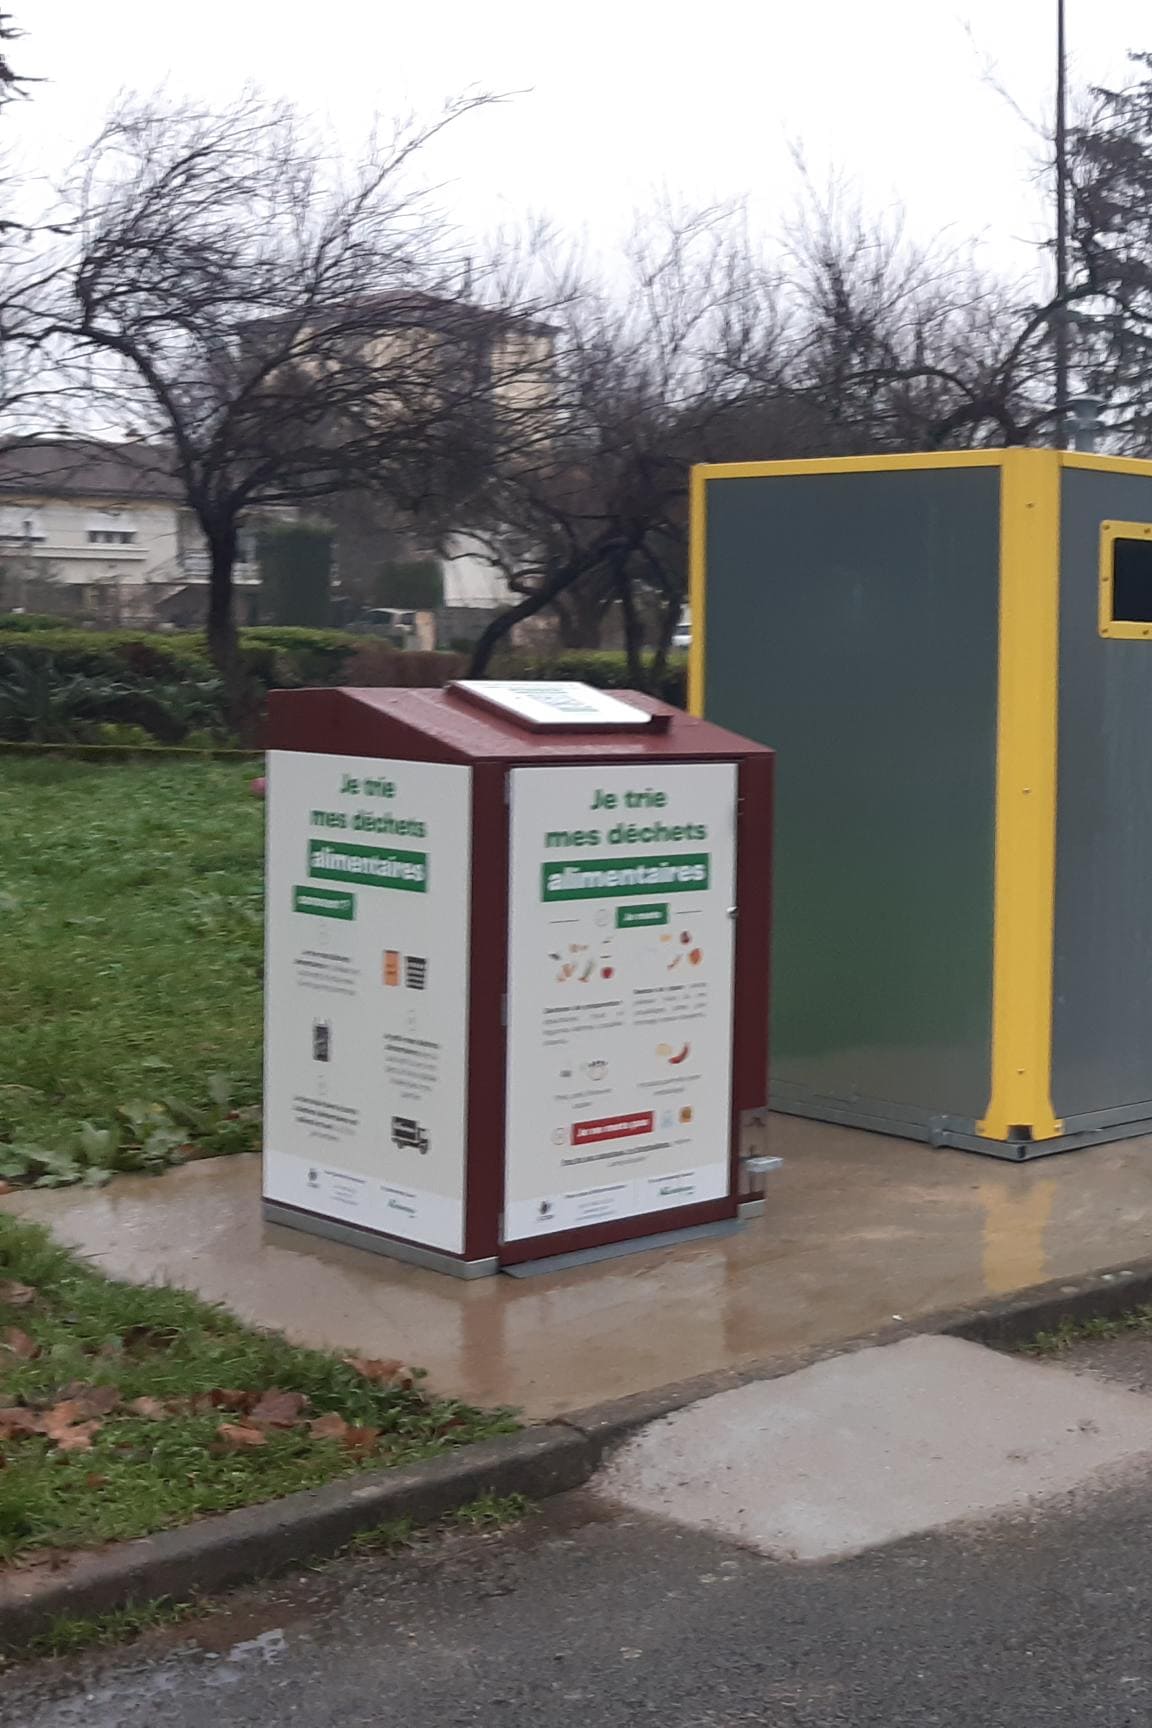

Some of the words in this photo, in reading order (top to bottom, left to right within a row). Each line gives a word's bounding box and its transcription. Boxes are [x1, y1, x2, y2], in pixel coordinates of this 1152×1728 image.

[339, 773, 361, 795] Je
[363, 776, 397, 798] trie
[590, 788, 618, 810] Je
[624, 786, 669, 808] trie
[310, 810, 347, 829] mes
[352, 808, 428, 838] déchets
[545, 829, 601, 848] mes
[607, 821, 708, 844] déchets
[547, 861, 707, 891] alimentaires
